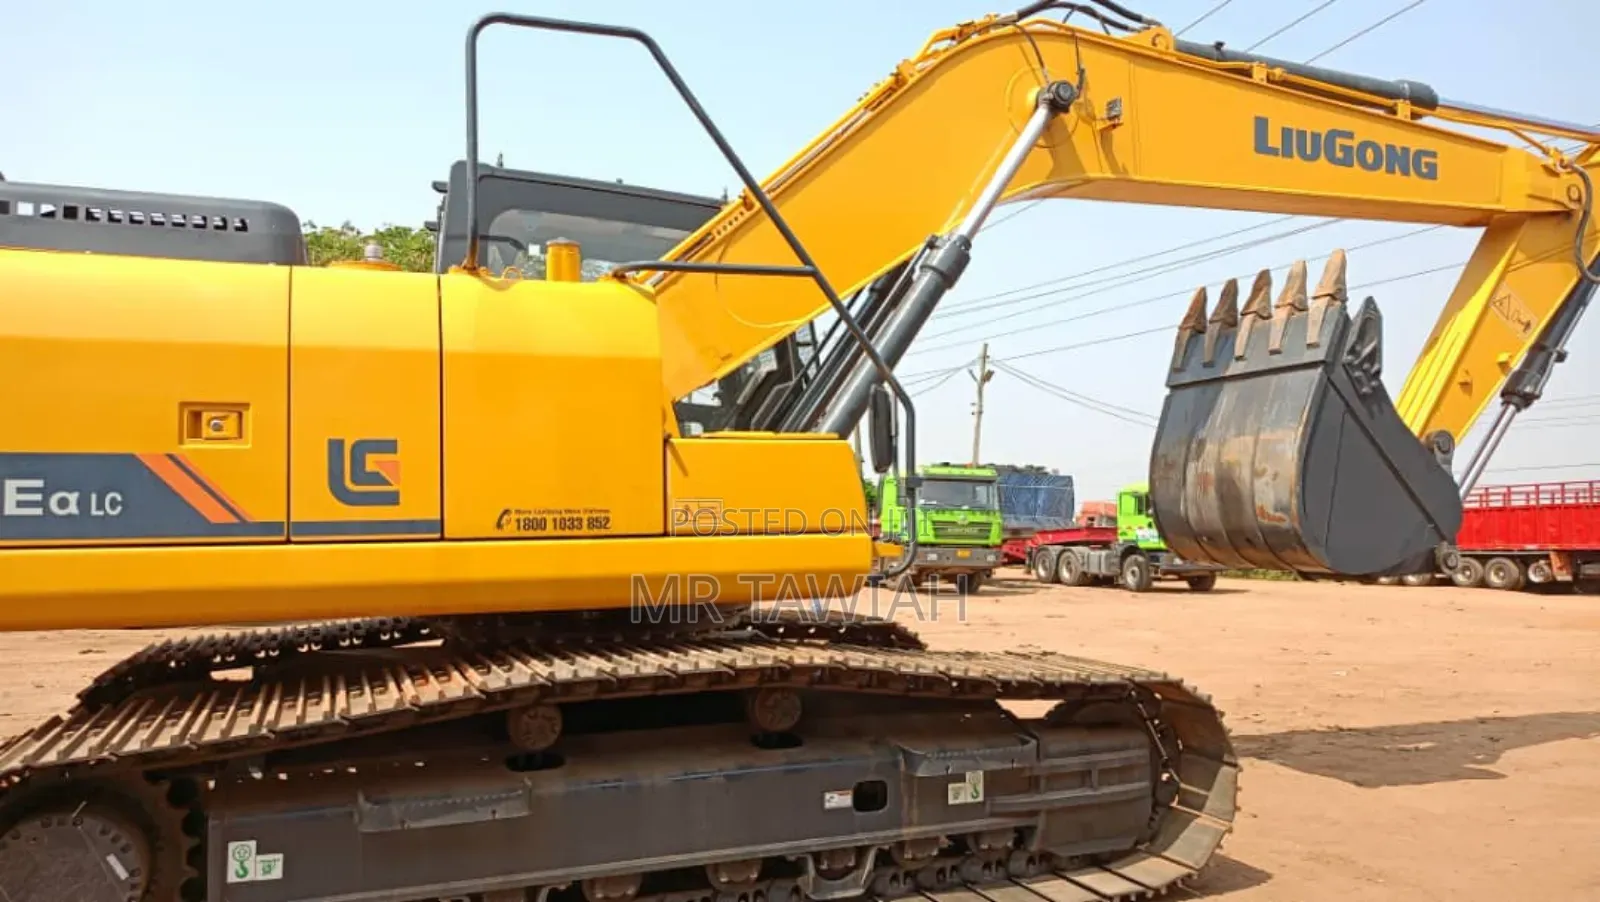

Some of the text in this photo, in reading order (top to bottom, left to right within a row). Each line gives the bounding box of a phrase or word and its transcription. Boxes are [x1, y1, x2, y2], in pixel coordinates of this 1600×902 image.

[1254, 116, 1438, 180] LIUGONG
[90, 491, 123, 516] LC
[515, 515, 611, 531] 1800 1033 852
